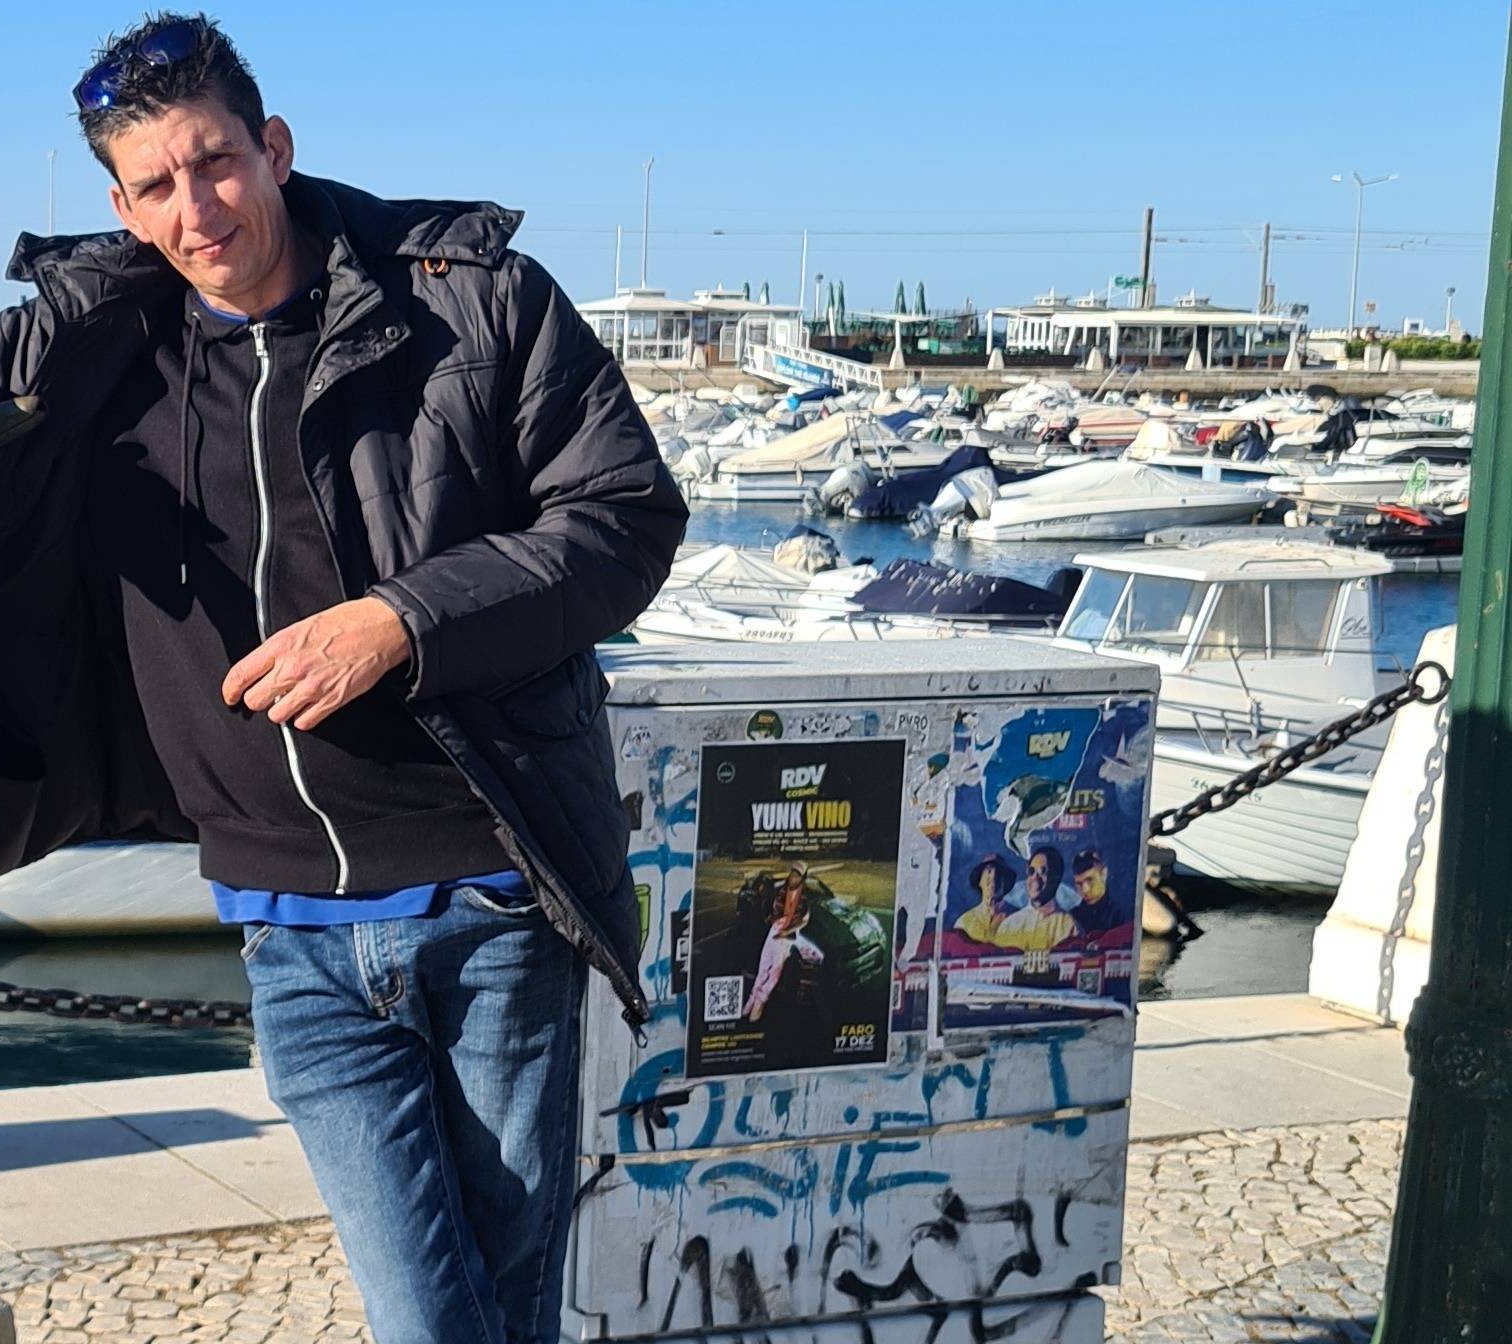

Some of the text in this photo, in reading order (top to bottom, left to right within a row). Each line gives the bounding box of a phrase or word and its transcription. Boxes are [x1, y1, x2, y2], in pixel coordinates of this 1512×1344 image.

[780, 763, 827, 790] RDV
[751, 800, 852, 831] YUNK VINO
[841, 1024, 875, 1036] FARO
[835, 1034, 876, 1048] 17 DEZ
